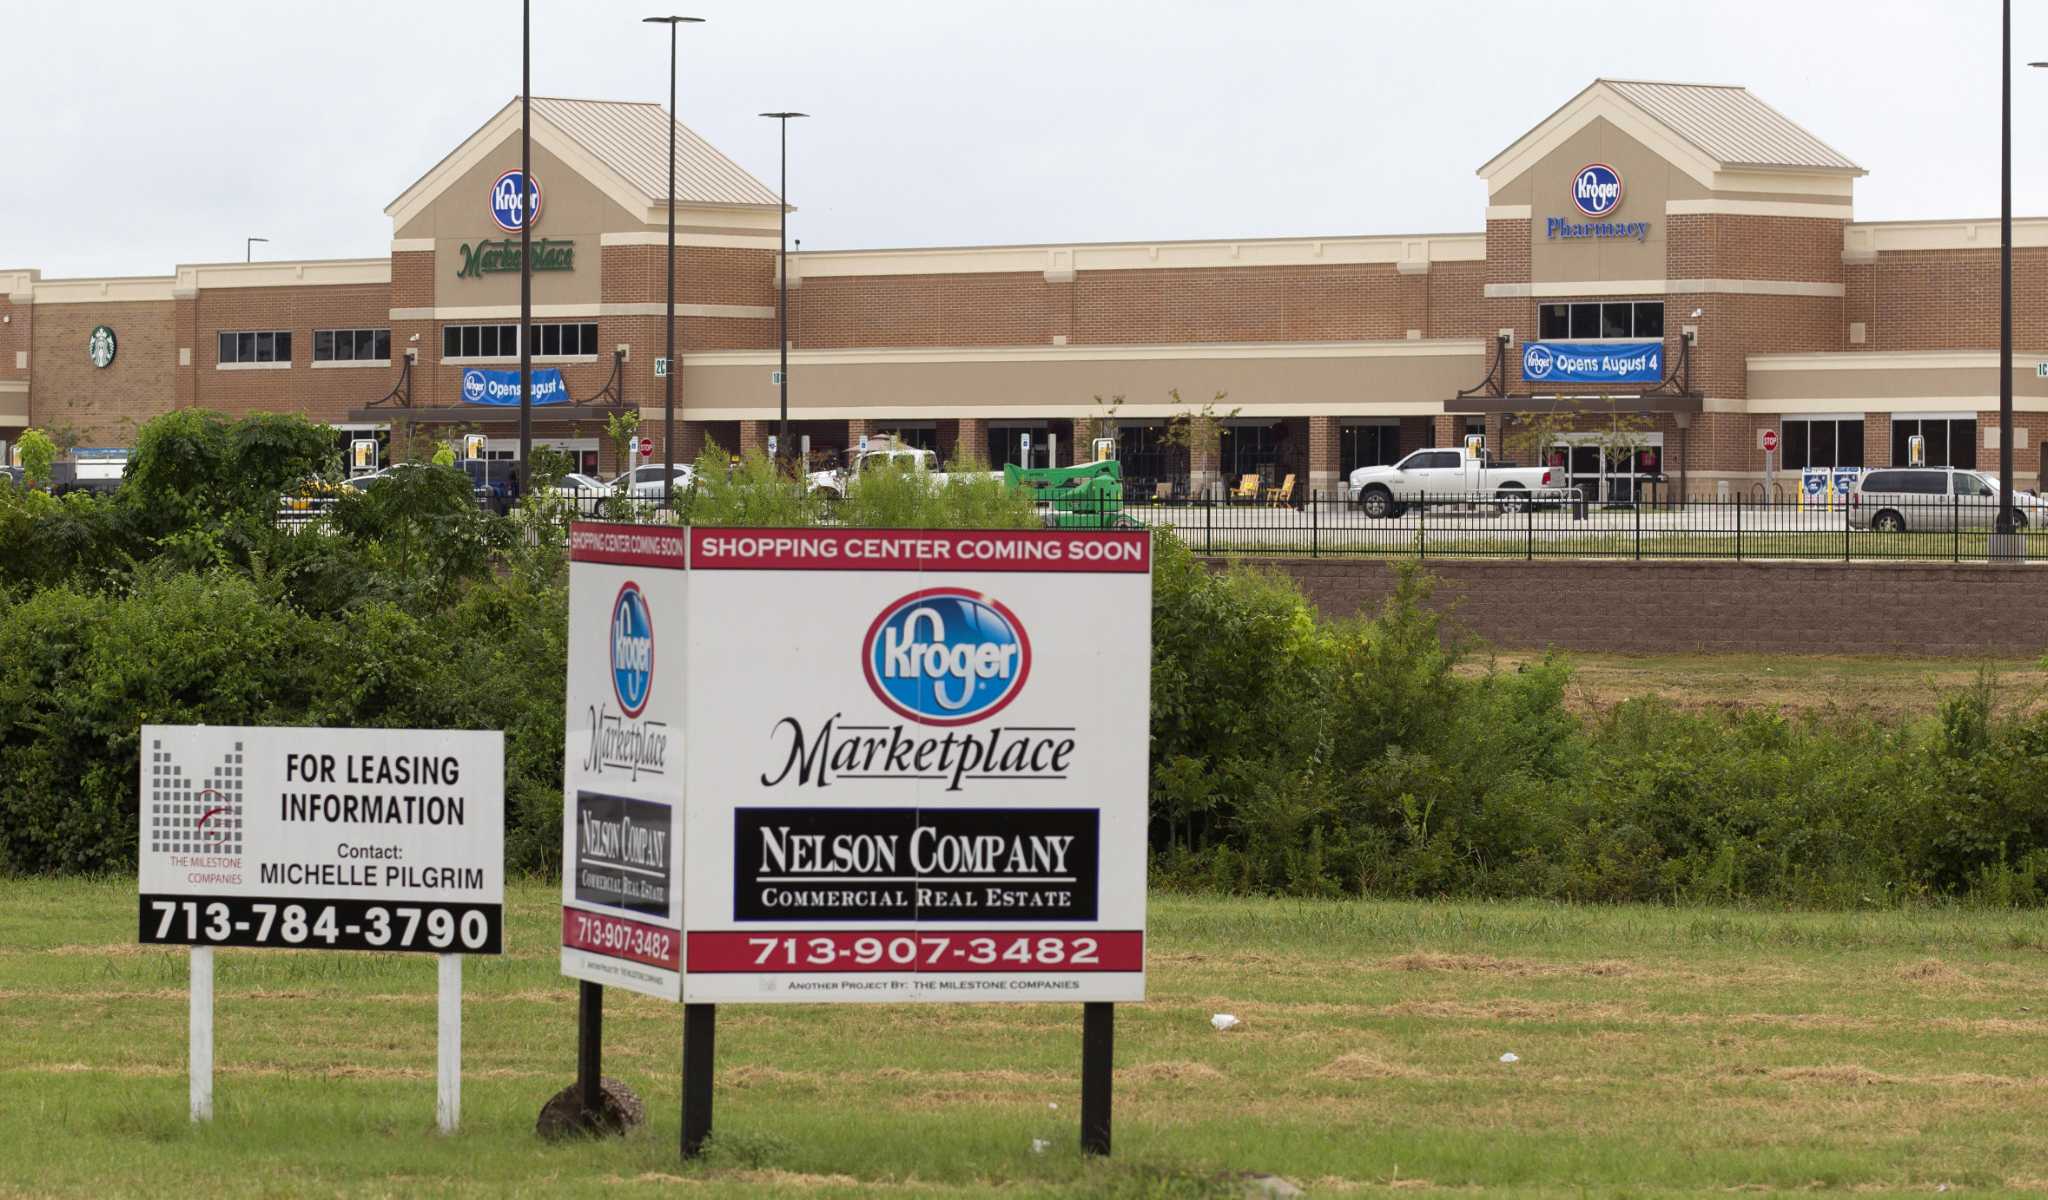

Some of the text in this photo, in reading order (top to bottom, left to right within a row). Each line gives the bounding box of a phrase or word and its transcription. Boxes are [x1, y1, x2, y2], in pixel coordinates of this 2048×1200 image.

[1578, 171, 1618, 211] Kroger
[1547, 217, 1649, 242] Pharmacy
[1527, 350, 1550, 374] Kroger
[1556, 354, 1658, 375] Opens August 4
[465, 375, 485, 396] Kroger
[488, 378, 566, 398] Opens ugust 4
[572, 532, 684, 556] SHOPPING CENTER COMING SOON
[701, 537, 1142, 561] SHOPPING CENTER COMING SOON
[616, 600, 651, 701] Kroger
[884, 607, 1017, 710] Kroger
[584, 703, 667, 782] Marketplace
[761, 712, 1076, 791] Marketplace
[286, 753, 460, 786] FOR LEASING
[281, 793, 465, 826] INFORMATION
[337, 843, 403, 860] Contact:
[582, 809, 666, 868] NELSON COMPANY
[758, 826, 1075, 874] NELSON COMPANY
[170, 855, 242, 869] THE MILESTONE
[260, 862, 485, 890] MICHELLE PILGRIM
[187, 872, 243, 885] COMPANIES
[761, 888, 1072, 907] COMMERCIAL REAL ESTATE
[152, 901, 489, 949] 713-784-3790
[577, 917, 670, 961] 713-907-3482
[748, 936, 1100, 966] 713-907-3482
[912, 980, 937, 990] THE
[939, 980, 1007, 990] MILESTONE
[1009, 980, 1080, 990] COMPANIES
